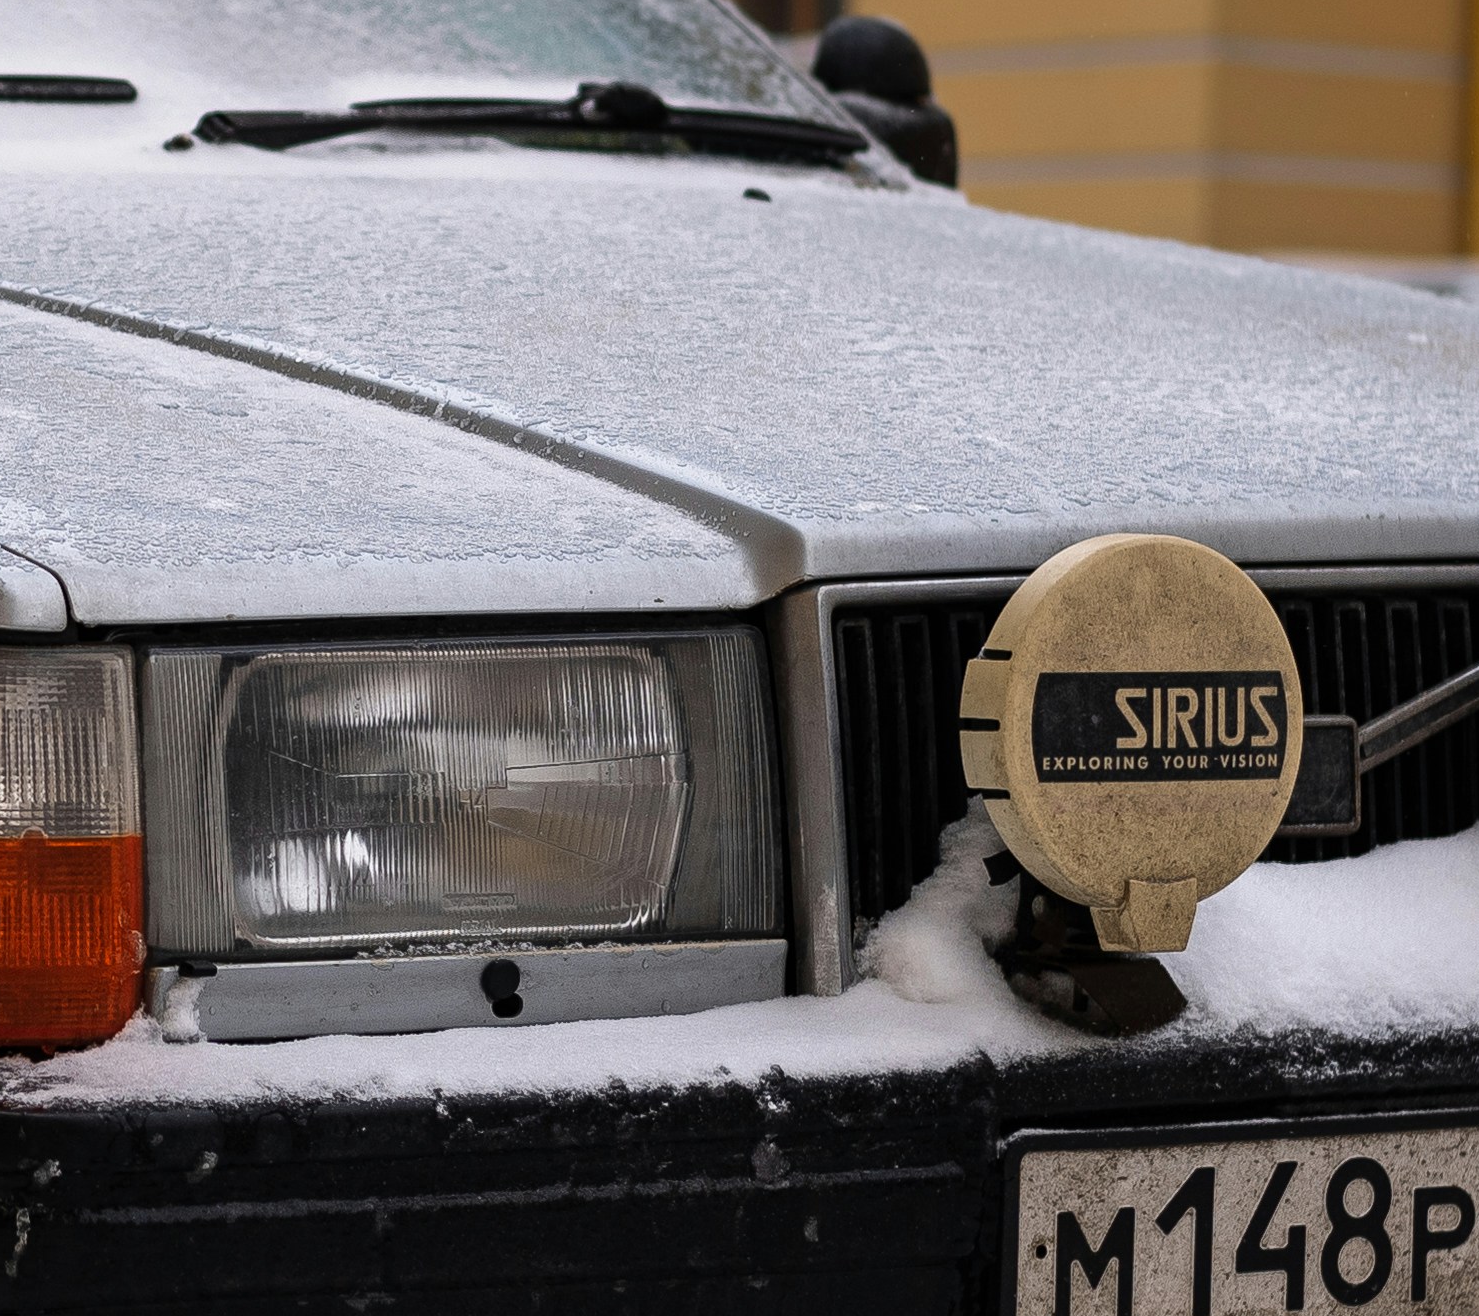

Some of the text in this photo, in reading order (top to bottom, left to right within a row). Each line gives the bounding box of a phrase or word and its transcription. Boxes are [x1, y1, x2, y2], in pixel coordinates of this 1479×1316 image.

[1115, 686, 1279, 749] SIRIUS
[1043, 753, 1278, 771] EXPLORING YOUR VISION
